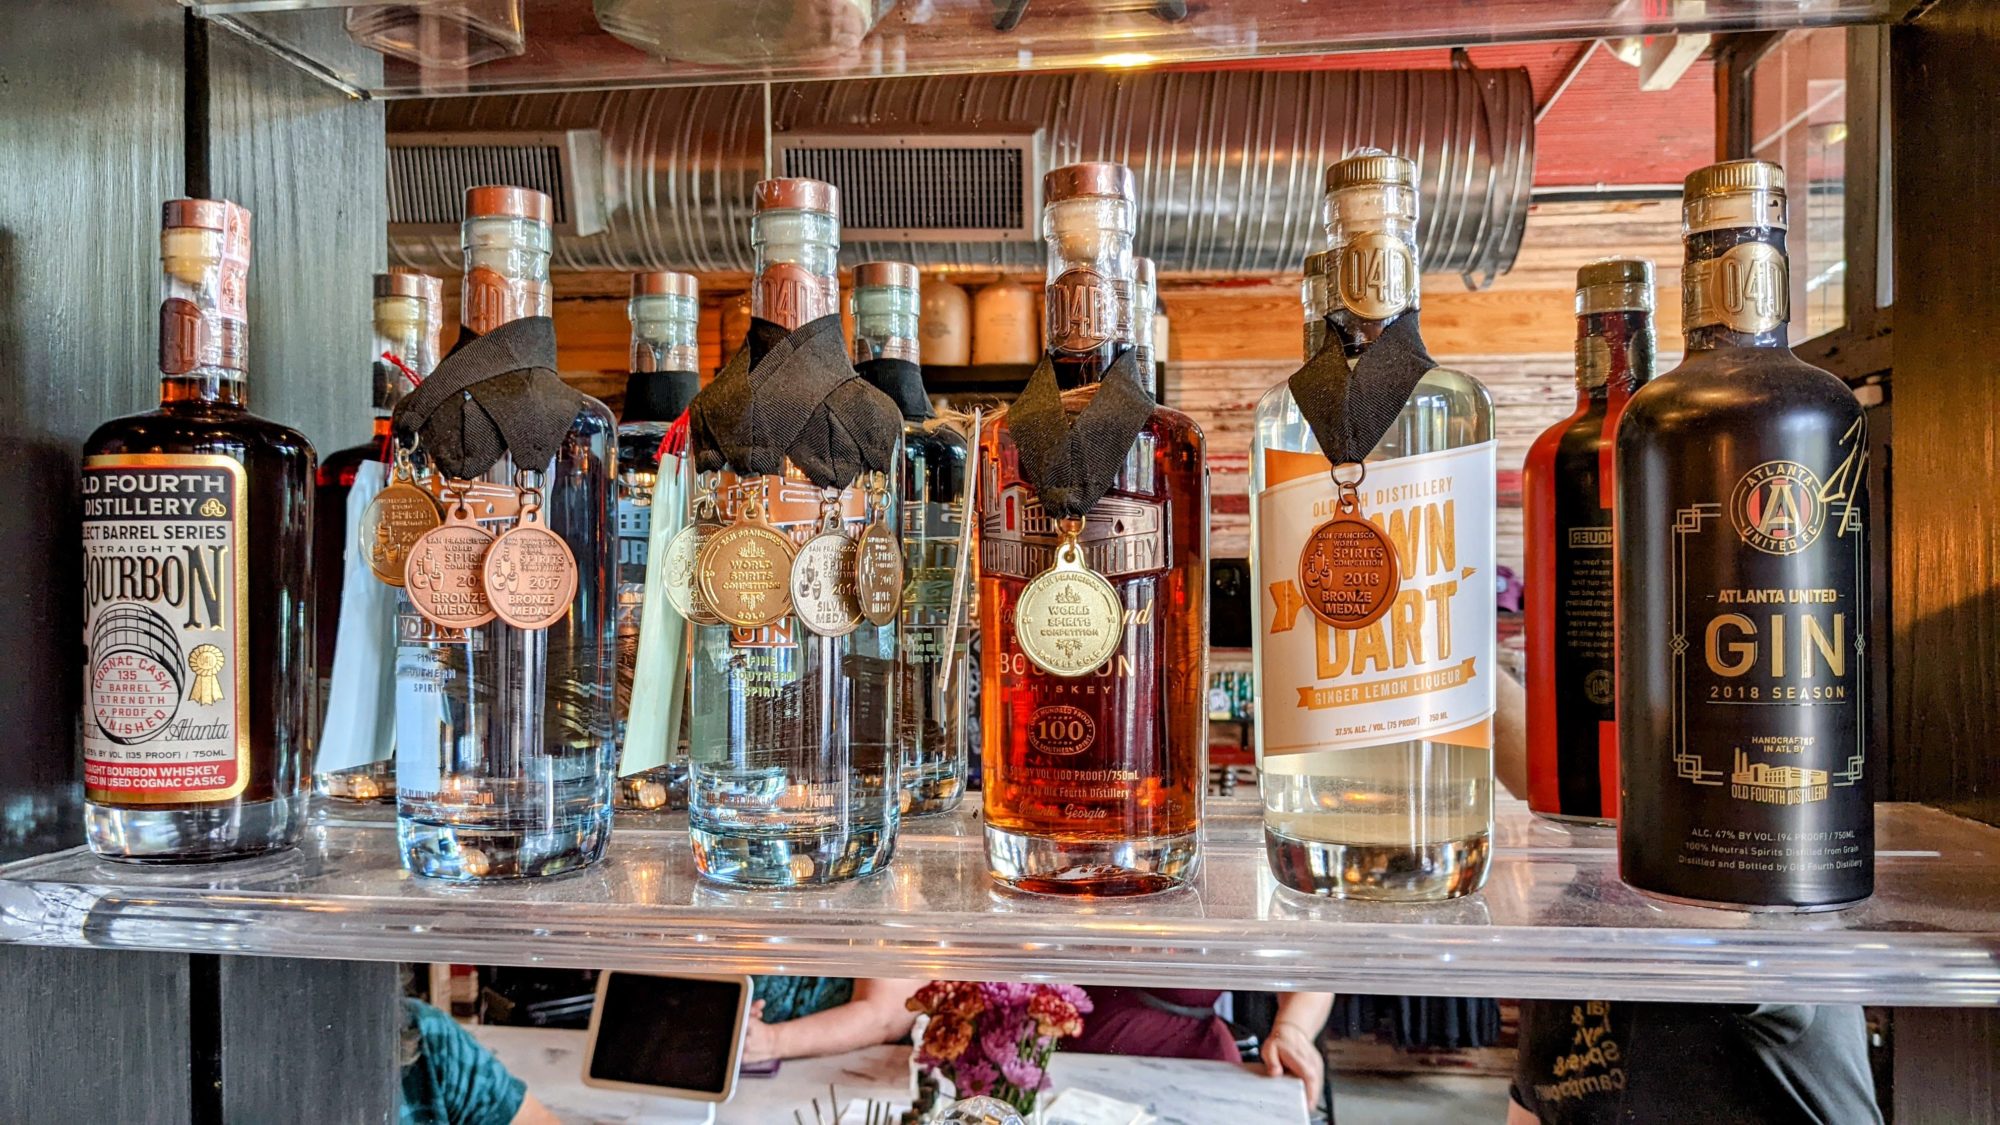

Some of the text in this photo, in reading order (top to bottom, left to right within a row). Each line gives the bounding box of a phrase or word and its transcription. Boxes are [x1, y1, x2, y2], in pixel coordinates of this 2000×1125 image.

[1746, 463, 1814, 488] ATLANTA
[82, 474, 225, 494] LD FOURTH
[1376, 476, 1453, 505] DISTILLERY
[85, 497, 198, 516] DISTILLERY
[82, 525, 226, 540] LECT BARREL SERIES
[1333, 531, 1375, 540] FRANCISCO
[1743, 525, 1818, 551] UNITED FC
[1368, 498, 1457, 581] WN
[92, 545, 176, 553] STRAIGHT
[1333, 548, 1383, 559] SPIRITS
[444, 553, 483, 563] SPIRI
[520, 554, 564, 564] SPIRITS
[729, 560, 773, 569] WORLD
[982, 536, 1158, 580] OLD FOURT TILLERY
[1333, 559, 1384, 567] COMPETITION
[823, 561, 856, 571] SPIRIT
[457, 575, 482, 587] 20
[529, 576, 561, 589] 2017
[729, 571, 774, 581] SPIRITS
[1344, 572, 1379, 586] 2018
[722, 582, 781, 590] COMPETITION
[431, 592, 486, 604] BRONZE
[508, 594, 555, 605] BRONZE
[1322, 591, 1372, 603] BRONZE
[1718, 588, 1837, 604] ATLANTA UNITED
[436, 604, 484, 615] MEDAL
[512, 606, 551, 616] MEDAL
[817, 601, 849, 612] SILVER
[1047, 605, 1091, 615] WORLD
[1123, 600, 1153, 625] nd
[1325, 603, 1369, 616] MEDAL
[815, 613, 851, 624] MEDAL
[1047, 617, 1092, 626] SPIRITS
[731, 616, 794, 643] GIN
[1040, 629, 1099, 637] COMPETITION
[1314, 581, 1458, 681] DART
[1705, 612, 1847, 679] GIN
[749, 655, 776, 666] FINE
[1000, 652, 1135, 677] BOON
[95, 655, 172, 691] COGNAC CASK
[118, 670, 138, 680] 135
[733, 671, 797, 682] SOUTHERN
[109, 683, 151, 693] BARREL
[744, 686, 784, 697] SPIRIT
[1015, 681, 1111, 694] WHISKEY
[1314, 669, 1461, 705] GINGER LEMON LIQUEUR
[1711, 685, 1845, 700] 2018 SEASON
[100, 696, 165, 705] STRENGTH
[112, 708, 147, 717] PROOF
[1040, 707, 1072, 715] HUNDRED
[1073, 709, 1093, 728] PROOF
[99, 708, 167, 736] FINISHED
[165, 717, 229, 742] Atlanta
[1038, 720, 1084, 741] 100
[1335, 726, 1353, 737] 37.5%
[1354, 725, 1367, 734] ALC.
[1373, 722, 1386, 731] VOL.
[1040, 743, 1075, 753] SOUTHERN
[1075, 734, 1092, 753] SPIRIT
[1751, 735, 1816, 747] HANDCRAFTED
[193, 750, 227, 758] 750ML
[1763, 745, 1805, 754] IN ATL BY
[107, 766, 158, 777] BOURBON
[160, 764, 220, 776] WHISKEY
[1036, 769, 1050, 779] VOL
[108, 777, 131, 788] USED
[133, 777, 182, 788] COGNAC
[184, 775, 226, 787] CASKS
[1060, 787, 1087, 798] Fourth
[1090, 786, 1130, 799] Distillery
[1731, 783, 1827, 806] OLD FOURTH DISTILLERY
[1064, 803, 1108, 820] Georgia
[1691, 827, 1712, 838] ALC.
[1715, 829, 1736, 840] 47%
[1738, 831, 1751, 841] BY
[1754, 832, 1776, 842] VOL.
[1834, 830, 1856, 840] 750ML
[1685, 841, 1859, 858] 100% Neutral Spirits Distilled from Grain
[1678, 854, 1715, 868] Distilled
[1717, 857, 1735, 869] and
[1738, 859, 1774, 871] Bottled
[1776, 860, 1788, 872] by
[1807, 858, 1835, 871] Fourth
